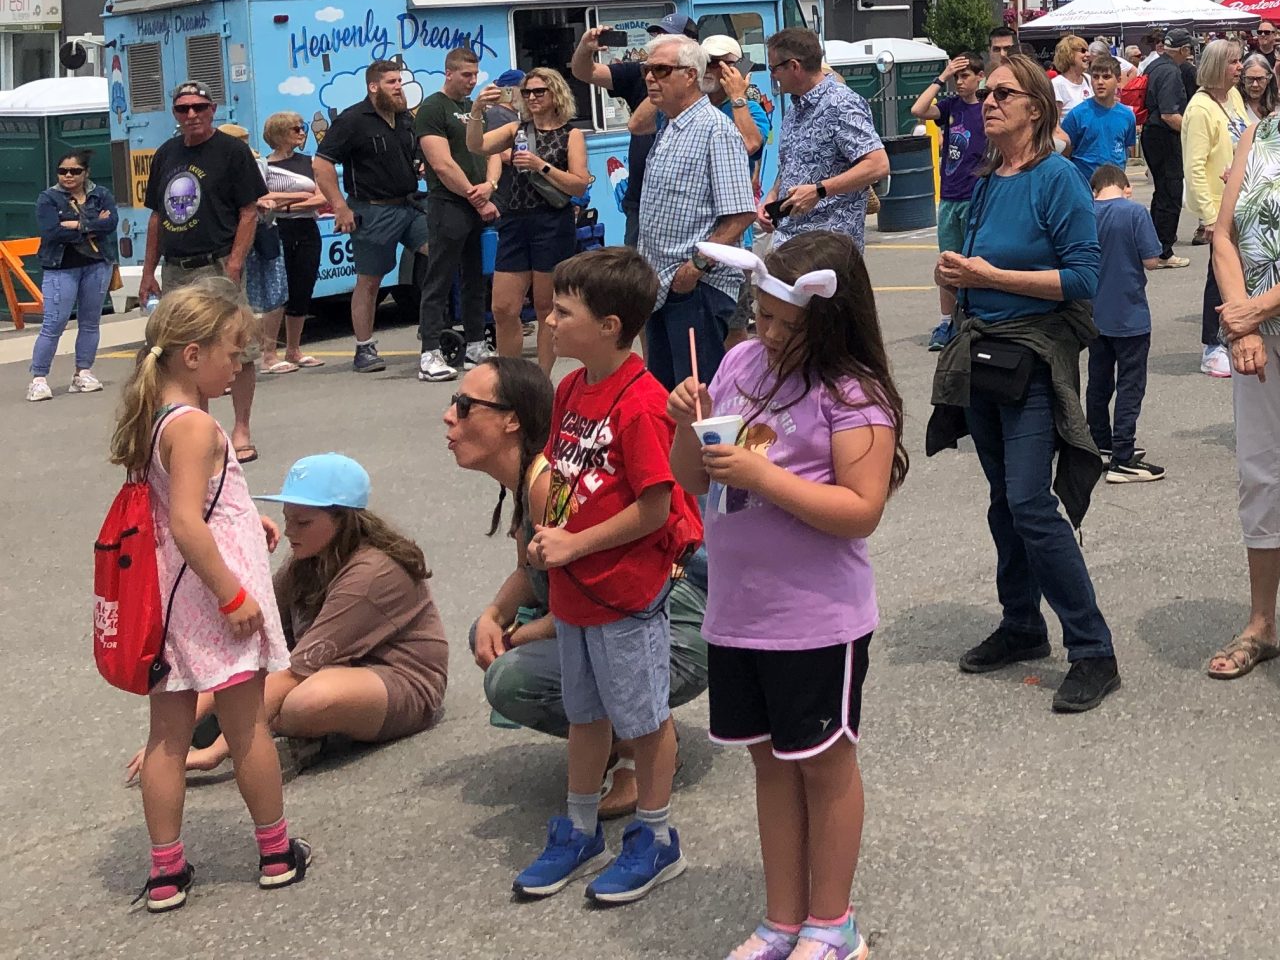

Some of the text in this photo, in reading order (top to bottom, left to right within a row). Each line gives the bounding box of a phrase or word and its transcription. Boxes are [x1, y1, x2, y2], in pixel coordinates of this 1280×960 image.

[137, 10, 210, 45] Heavenly Dreams
[290, 8, 498, 70] Heavenly Dreams
[317, 265, 356, 281] ASKATOON
